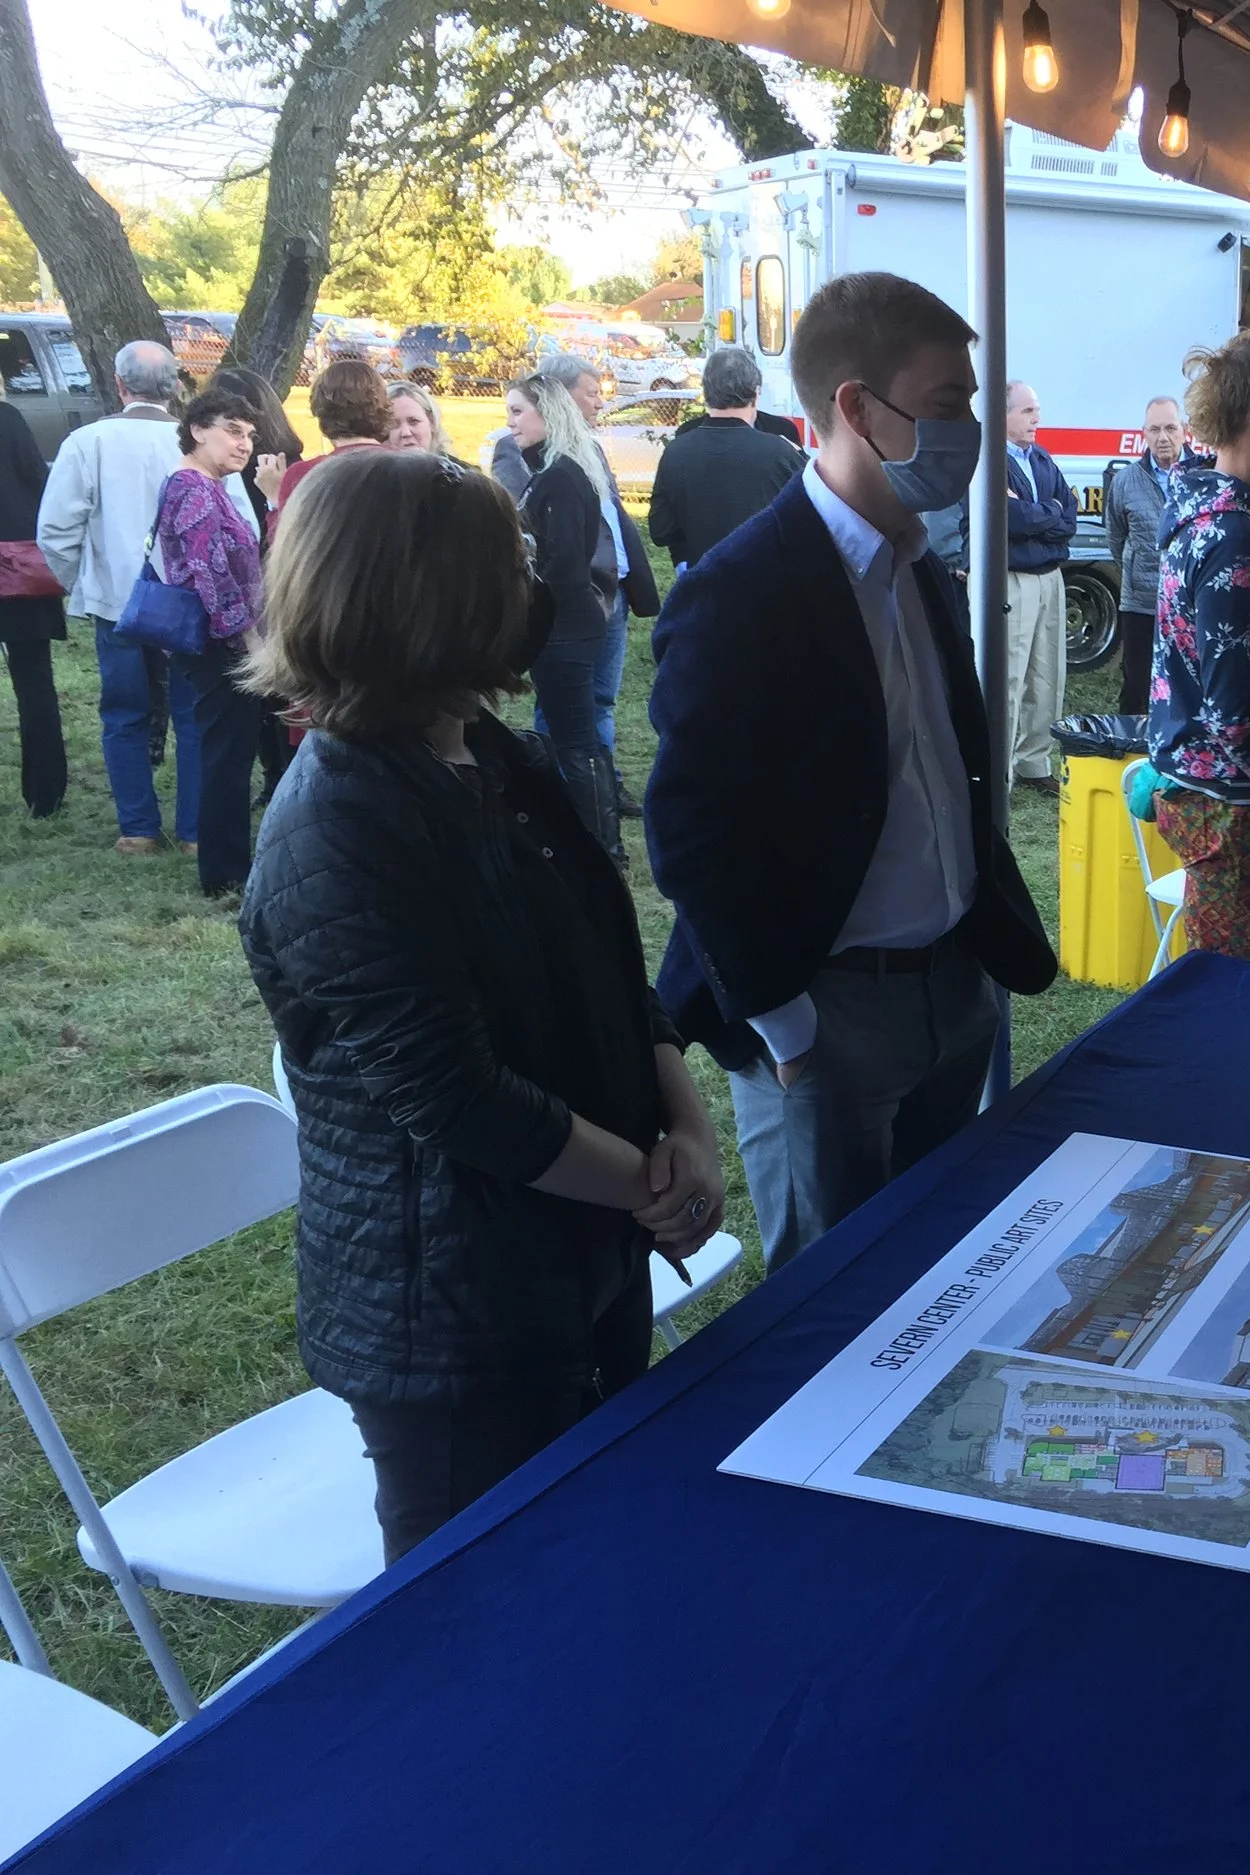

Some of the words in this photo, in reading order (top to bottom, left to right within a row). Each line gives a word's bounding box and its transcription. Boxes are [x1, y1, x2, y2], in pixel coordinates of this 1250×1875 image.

[1019, 1198, 1065, 1225] SITES
[1000, 1222, 1040, 1245] ART
[964, 1243, 1021, 1278] PUBLIC
[916, 1283, 980, 1325] CENTER
[869, 1324, 939, 1370] SEVERN
